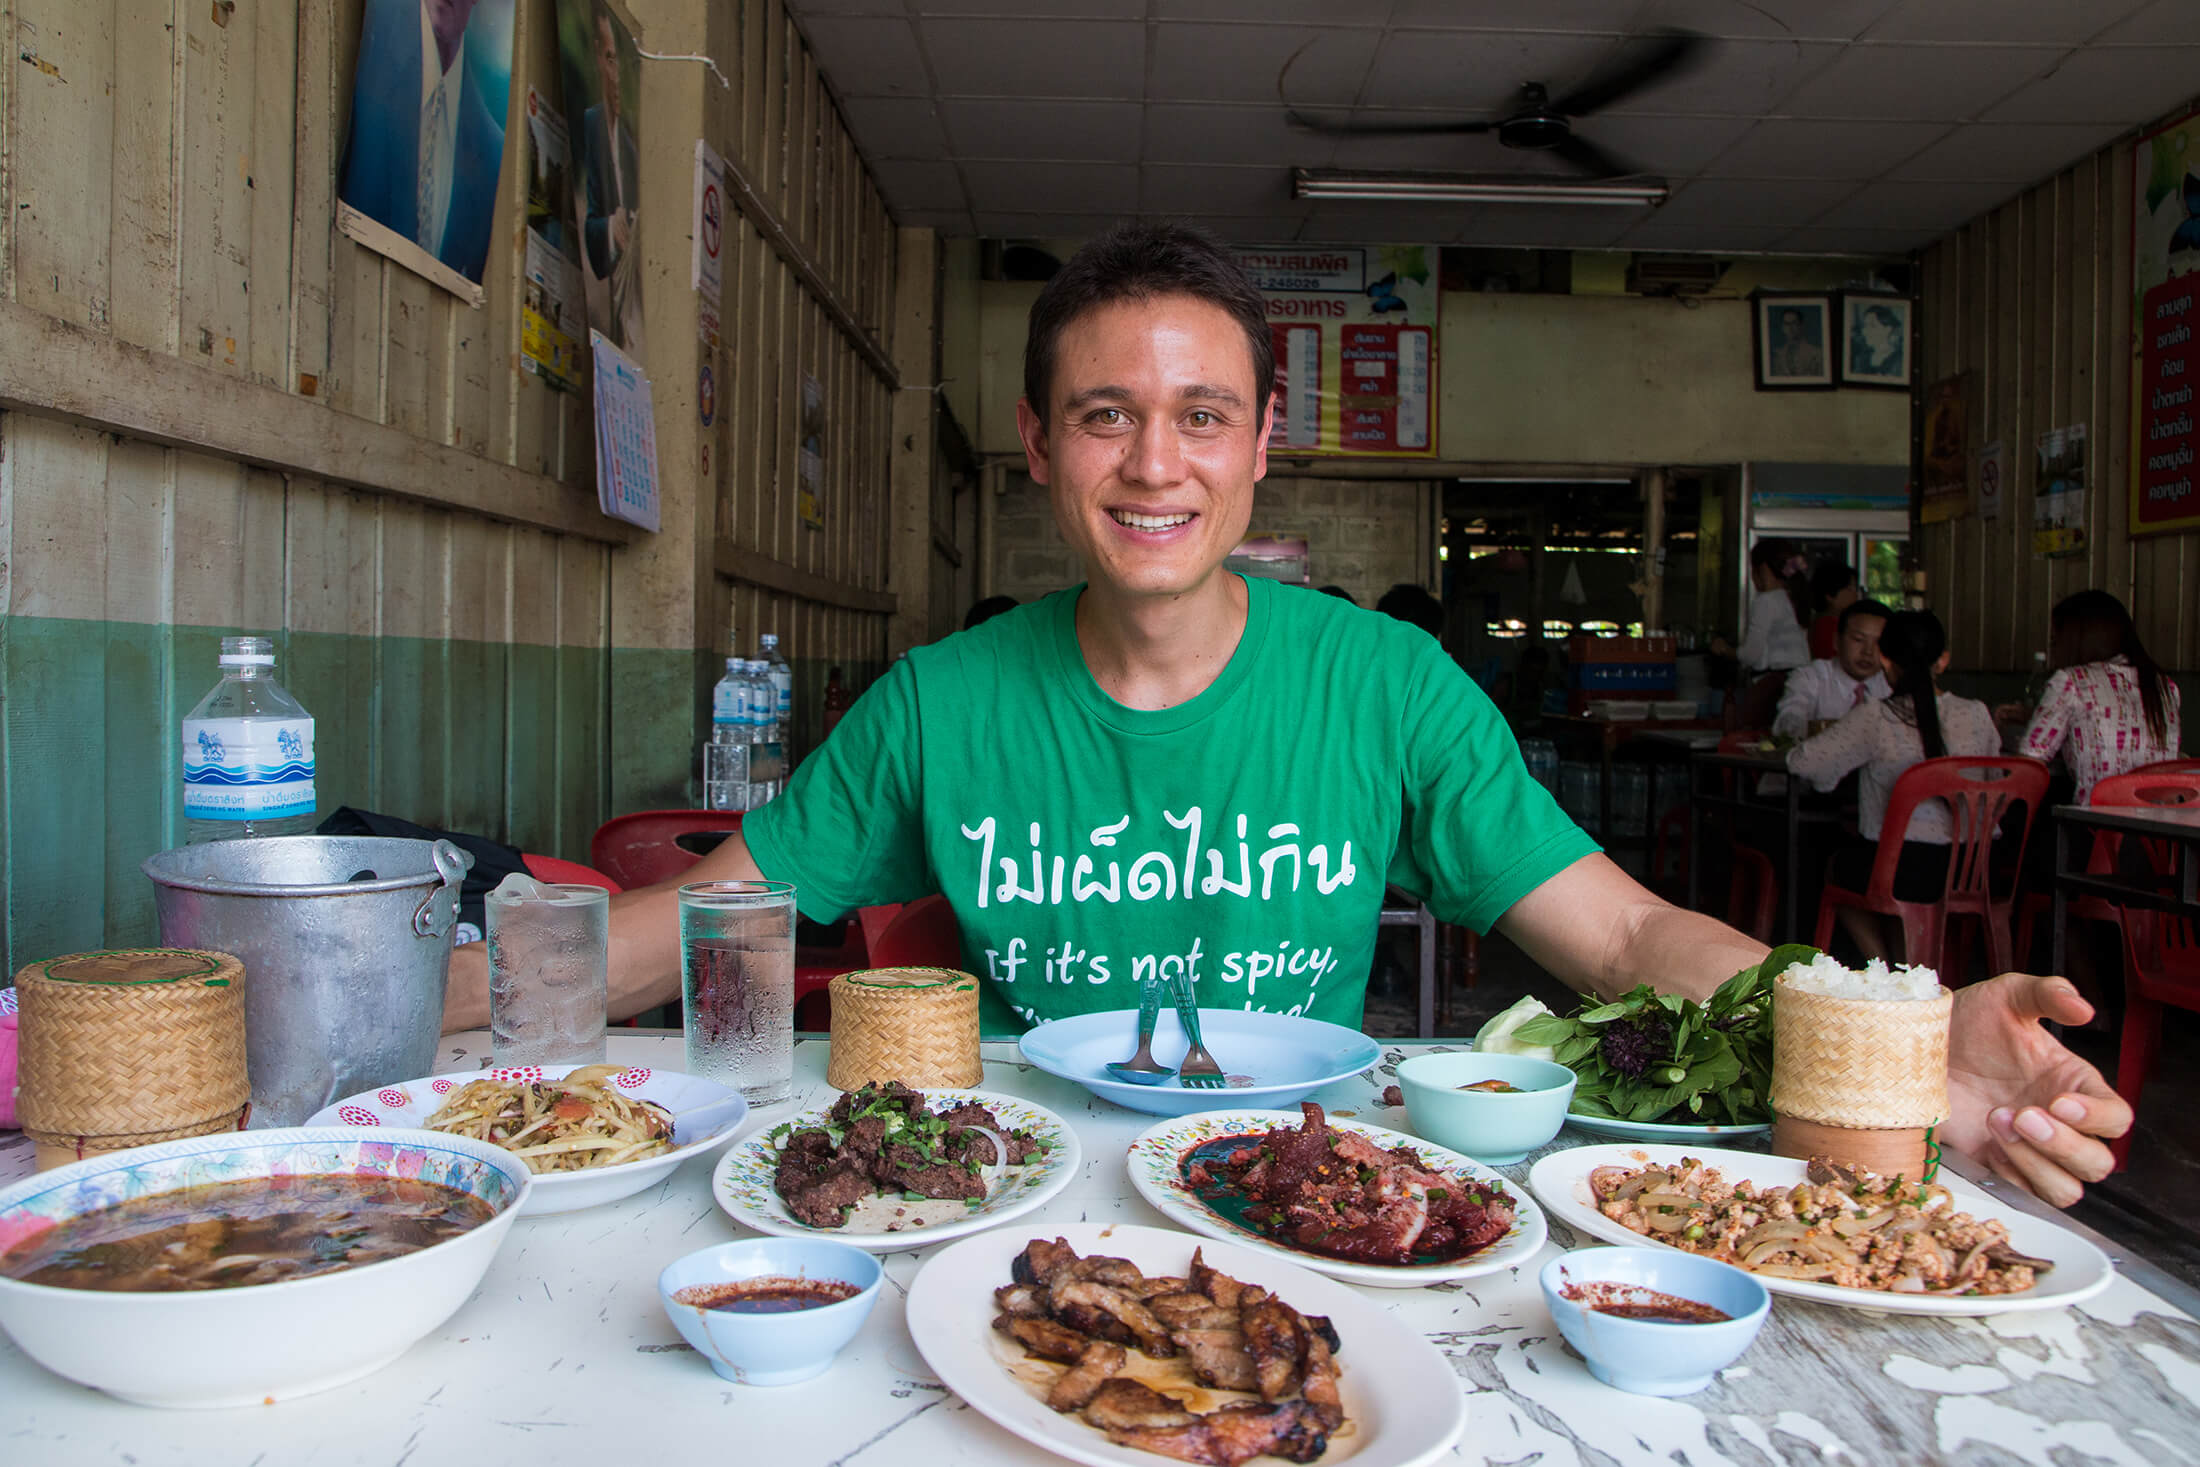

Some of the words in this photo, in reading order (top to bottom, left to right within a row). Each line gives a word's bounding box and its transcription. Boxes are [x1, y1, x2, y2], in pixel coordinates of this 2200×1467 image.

[1249, 278, 1320, 289] 4-245026
[961, 806, 1357, 908] ไม่เผ็ดไม่กิน
[985, 937, 1027, 983] If
[1046, 941, 1111, 985] it's
[1131, 937, 1204, 982] not
[1221, 940, 1339, 996] spicy,
